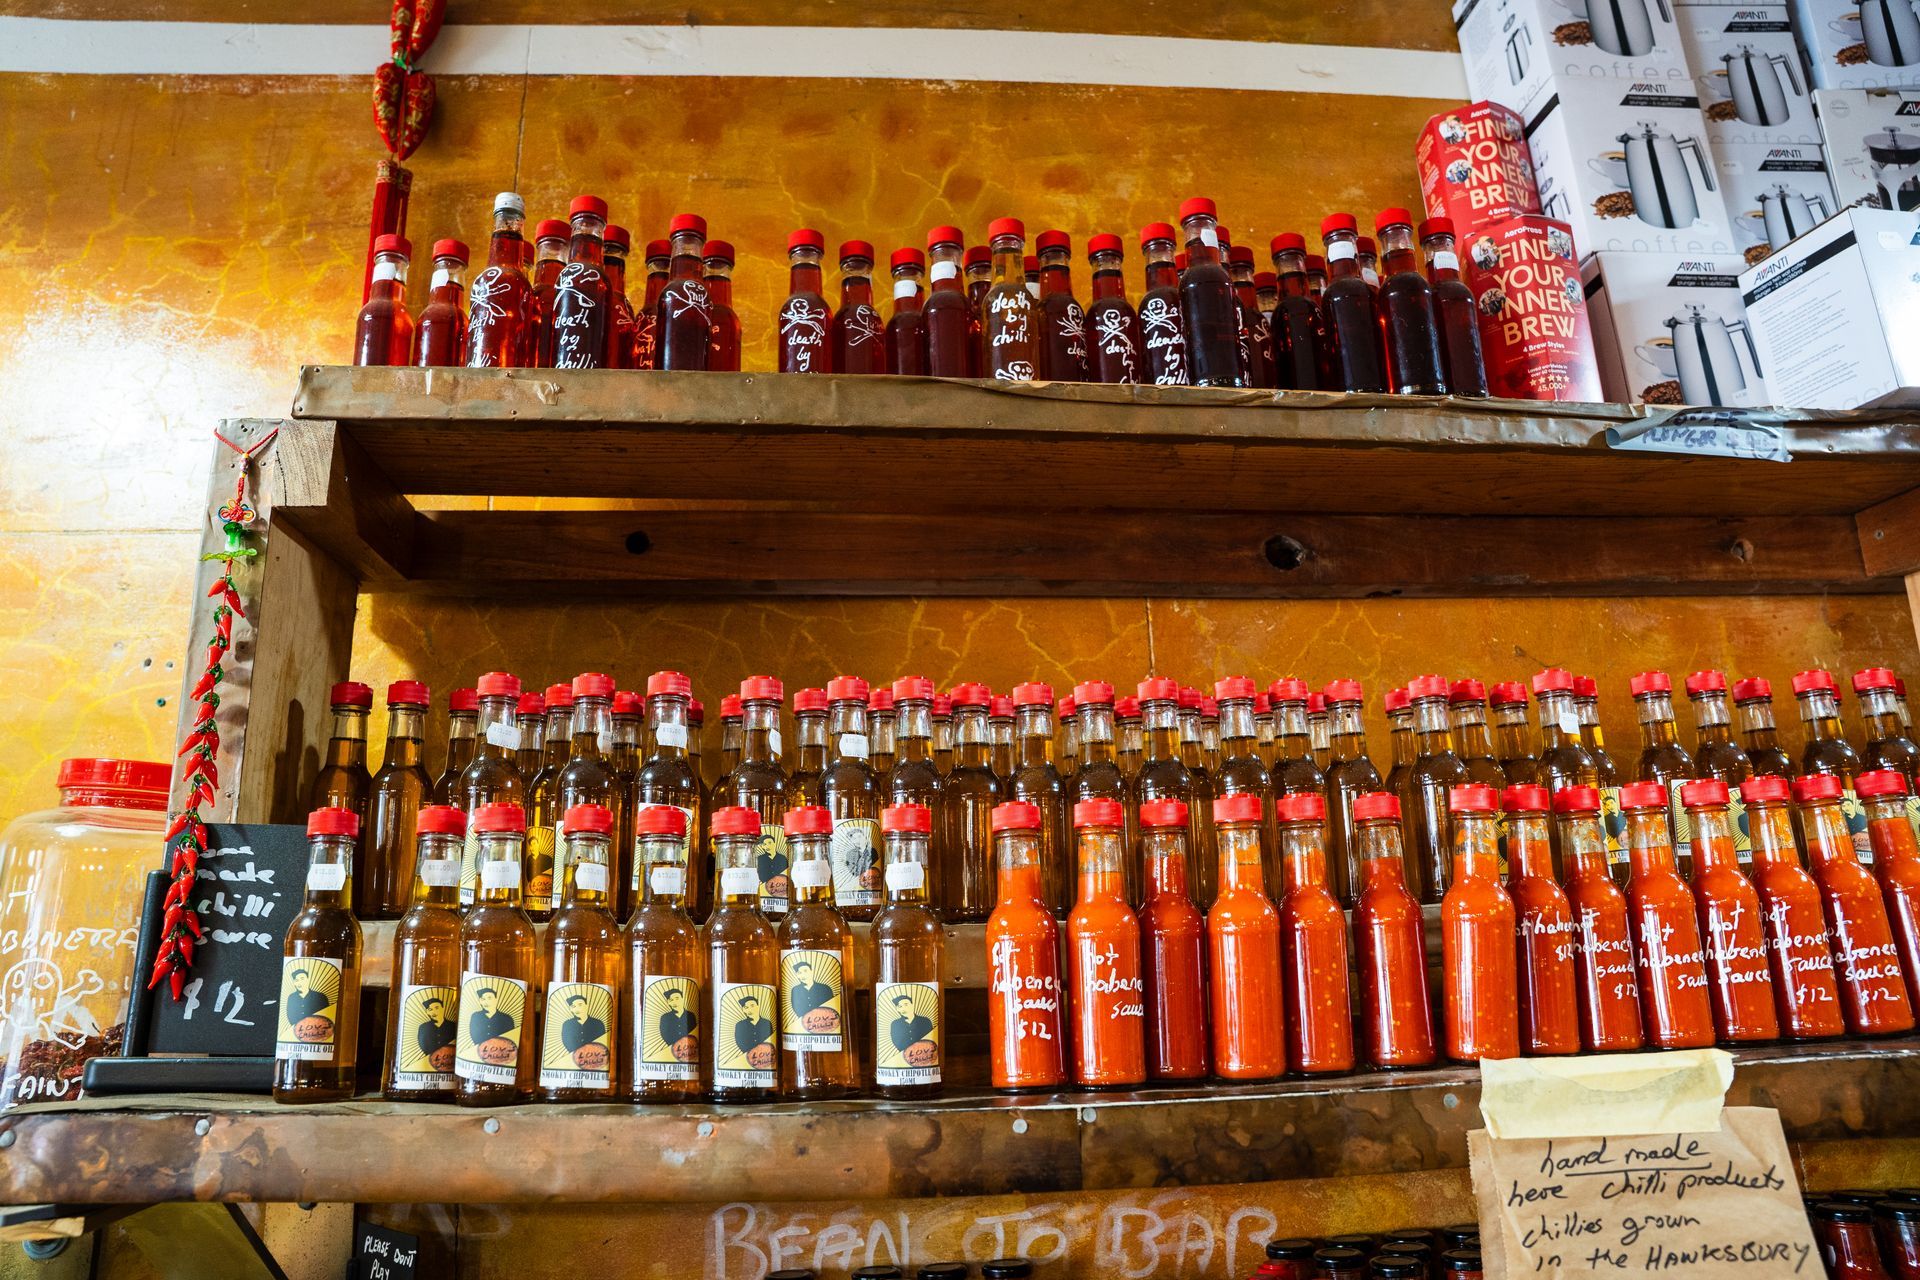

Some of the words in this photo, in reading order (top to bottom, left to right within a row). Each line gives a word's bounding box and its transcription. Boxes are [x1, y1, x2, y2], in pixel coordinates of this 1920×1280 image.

[1732, 11, 1768, 20] AVANTI
[1629, 83, 1667, 94] AVANTI
[1465, 118, 1514, 143] FIND
[1460, 140, 1520, 164] YOUR
[1766, 149, 1802, 159] AVANTI
[1469, 184, 1529, 210] BREW
[1498, 238, 1557, 268] FIND
[1493, 262, 1566, 294] YOUR
[1677, 262, 1716, 272] AVANTI
[1754, 255, 1789, 285] AVANTI
[992, 291, 1031, 313] death
[1498, 288, 1575, 322] INNER
[555, 309, 589, 329] death
[1005, 309, 1027, 331] by
[1503, 314, 1575, 346] BREW
[560, 331, 580, 351] by
[788, 329, 822, 347] death
[993, 325, 1030, 346] chilli
[797, 346, 811, 371] by
[1164, 346, 1181, 368] by
[197, 891, 282, 918] chilli
[1796, 983, 1833, 1004] $12
[290, 1044, 322, 1053] CHIPOTLE
[799, 1035, 831, 1044] CHIPOTLE
[399, 1074, 424, 1082] SMOKEY
[472, 1064, 506, 1077] CHIPOTLE
[542, 1072, 567, 1080] SMOKEY
[569, 1072, 600, 1081] CHIPOTLE
[641, 1064, 666, 1072] SMOKEY
[717, 1072, 742, 1080] SMOKEY
[877, 1069, 900, 1078] SMOKEY
[901, 1069, 931, 1078] CHIPOTLE
[1540, 1136, 1615, 1178] hand
[1625, 1133, 1710, 1161] made
[1508, 1180, 1568, 1207] here
[1601, 1168, 1667, 1200] chilli
[1677, 1161, 1784, 1199] products
[713, 1202, 910, 1280] BEAN
[1110, 1205, 1279, 1280] BAR
[1522, 1212, 1603, 1248] chillies
[1620, 1214, 1701, 1246] grown
[363, 1235, 391, 1257] PLEASE
[1536, 1255, 1561, 1272] in
[1586, 1248, 1628, 1270] the
[1645, 1241, 1809, 1274] HAWKSBURY
[370, 1258, 390, 1280] PLAY
